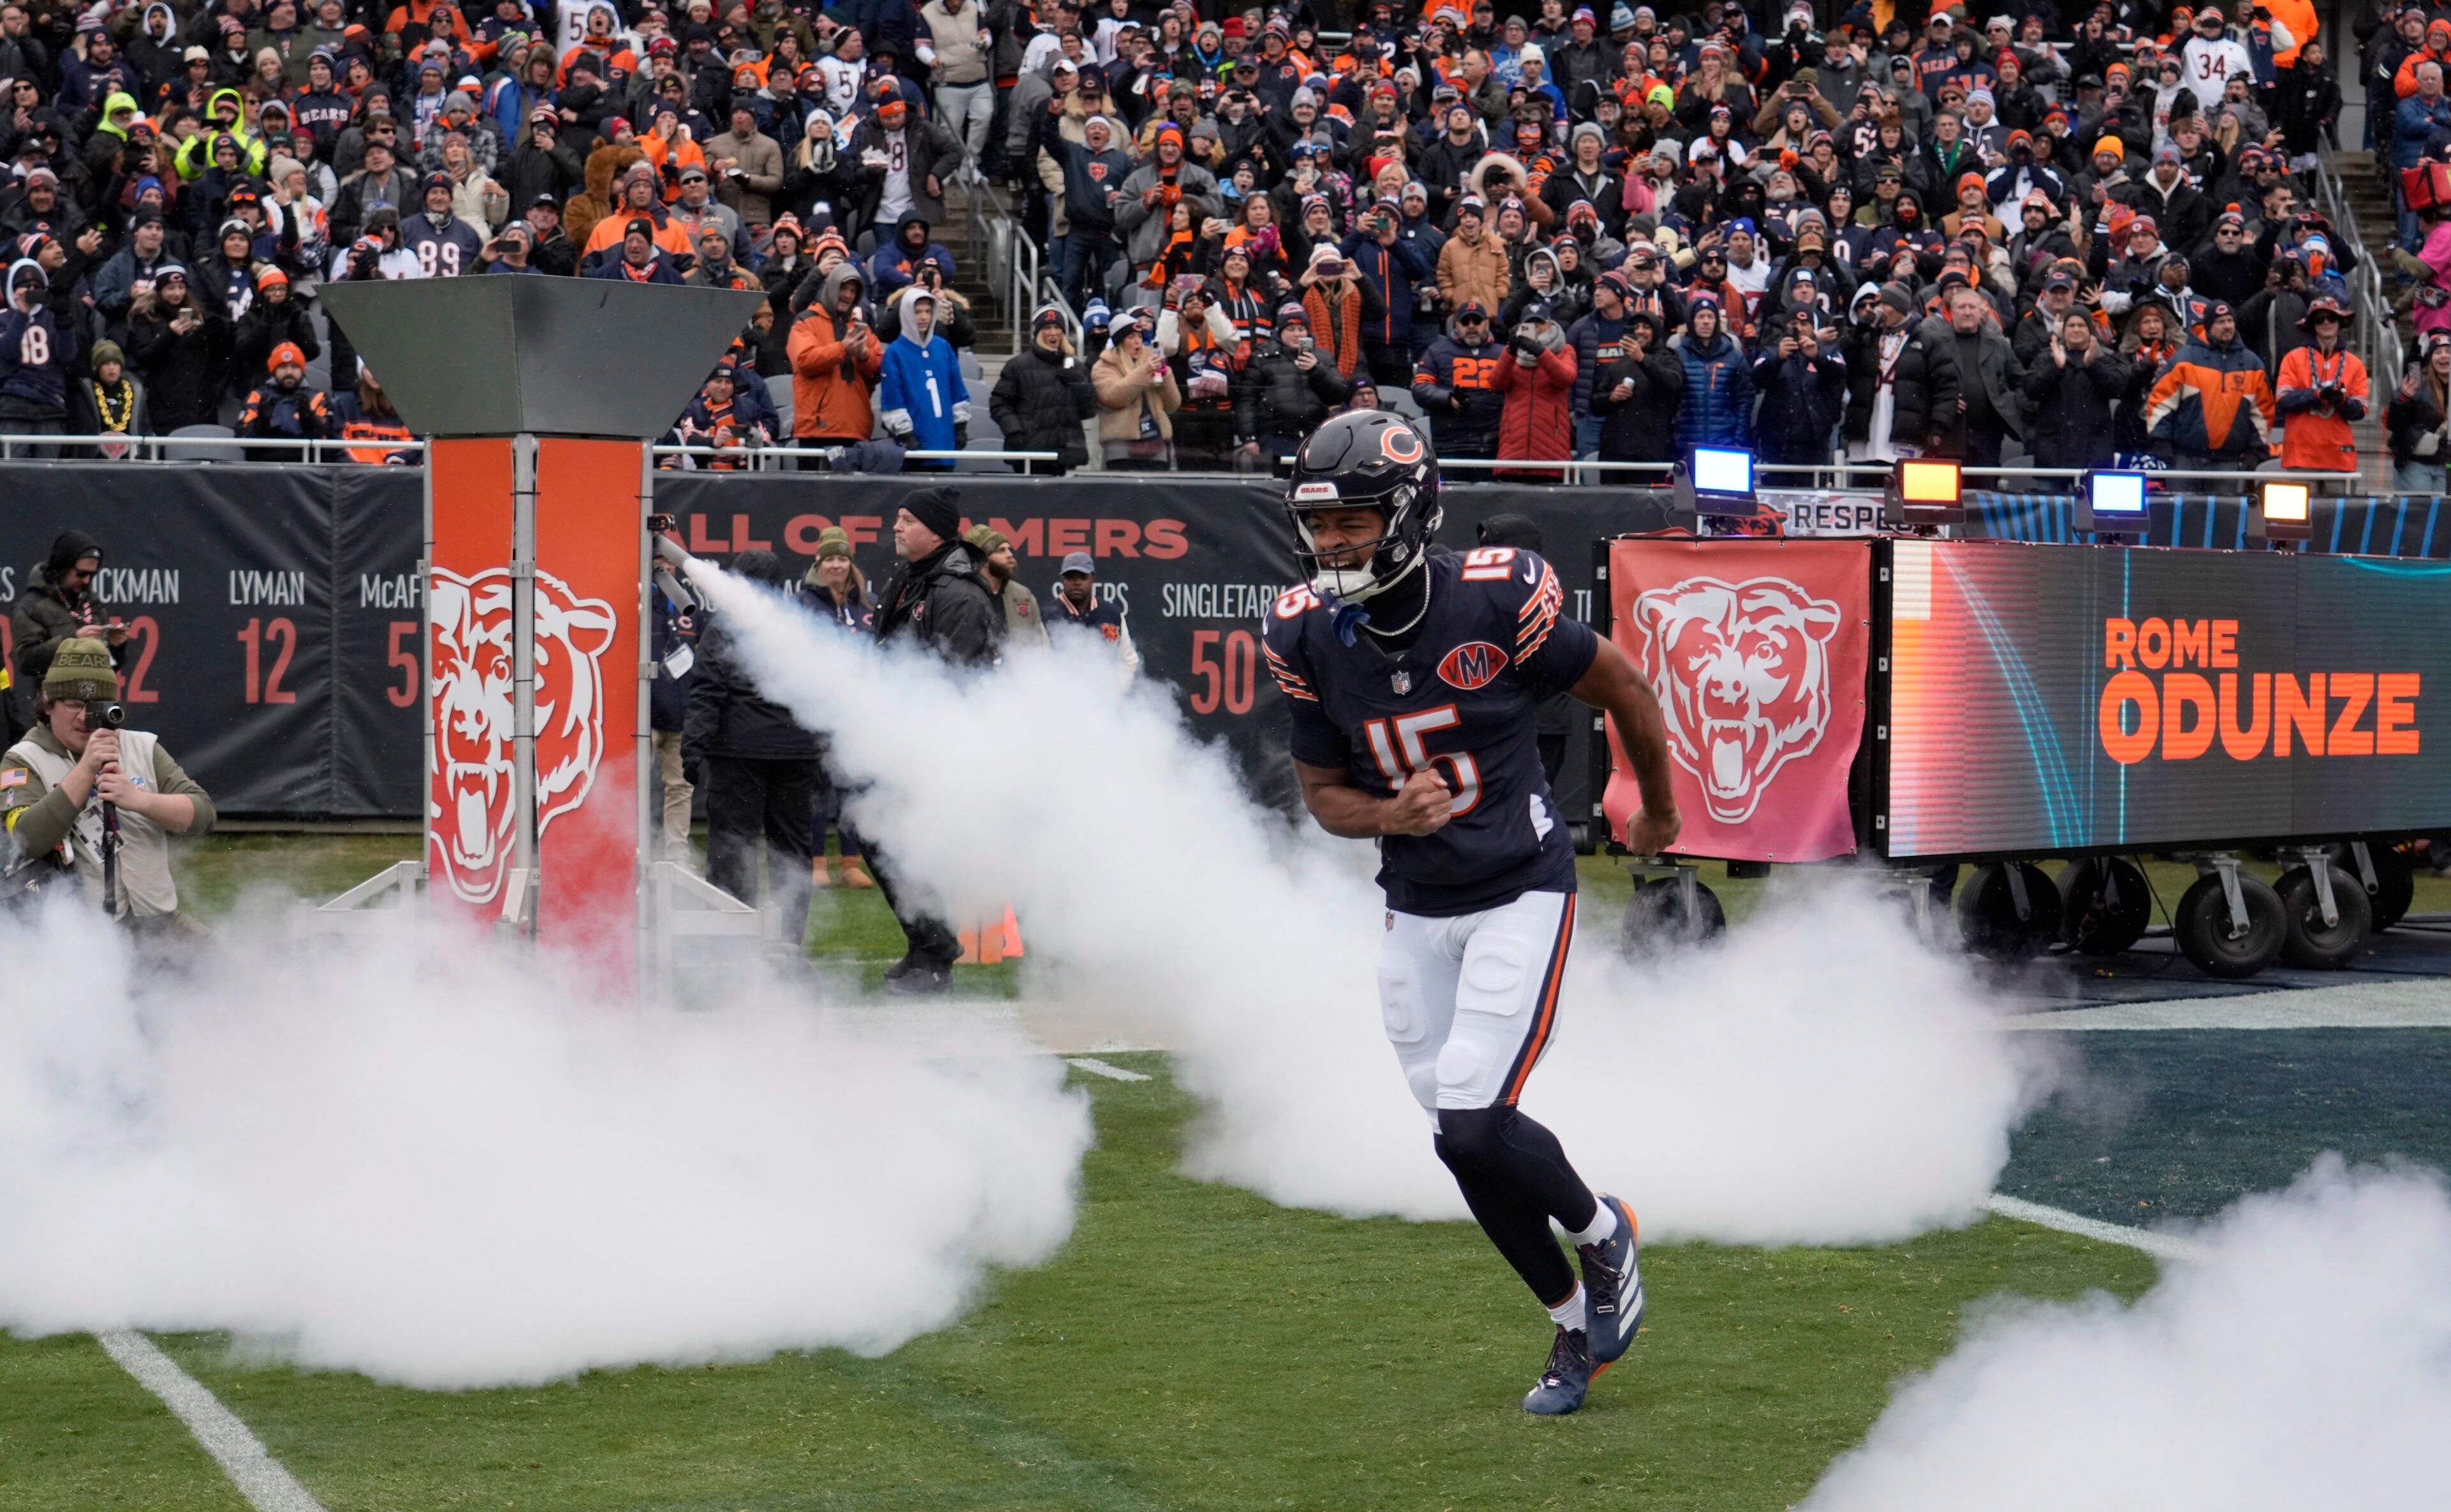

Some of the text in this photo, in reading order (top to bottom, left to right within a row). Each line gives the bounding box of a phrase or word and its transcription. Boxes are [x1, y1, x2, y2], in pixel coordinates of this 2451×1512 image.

[839, 70, 854, 99] 5
[2198, 53, 2226, 81] 34
[299, 107, 349, 126] BEARS
[418, 240, 460, 278] 89
[926, 377, 943, 418] 1
[784, 513, 883, 555] OF
[230, 570, 305, 606] LYMAN
[57, 654, 110, 668] BEARS
[109, 615, 159, 702] 2
[237, 617, 297, 704] 12
[2106, 617, 2238, 669] ROME
[1190, 629, 1255, 715] 50
[2099, 670, 2420, 764] ODUNZE
[1364, 703, 1482, 817] 15
